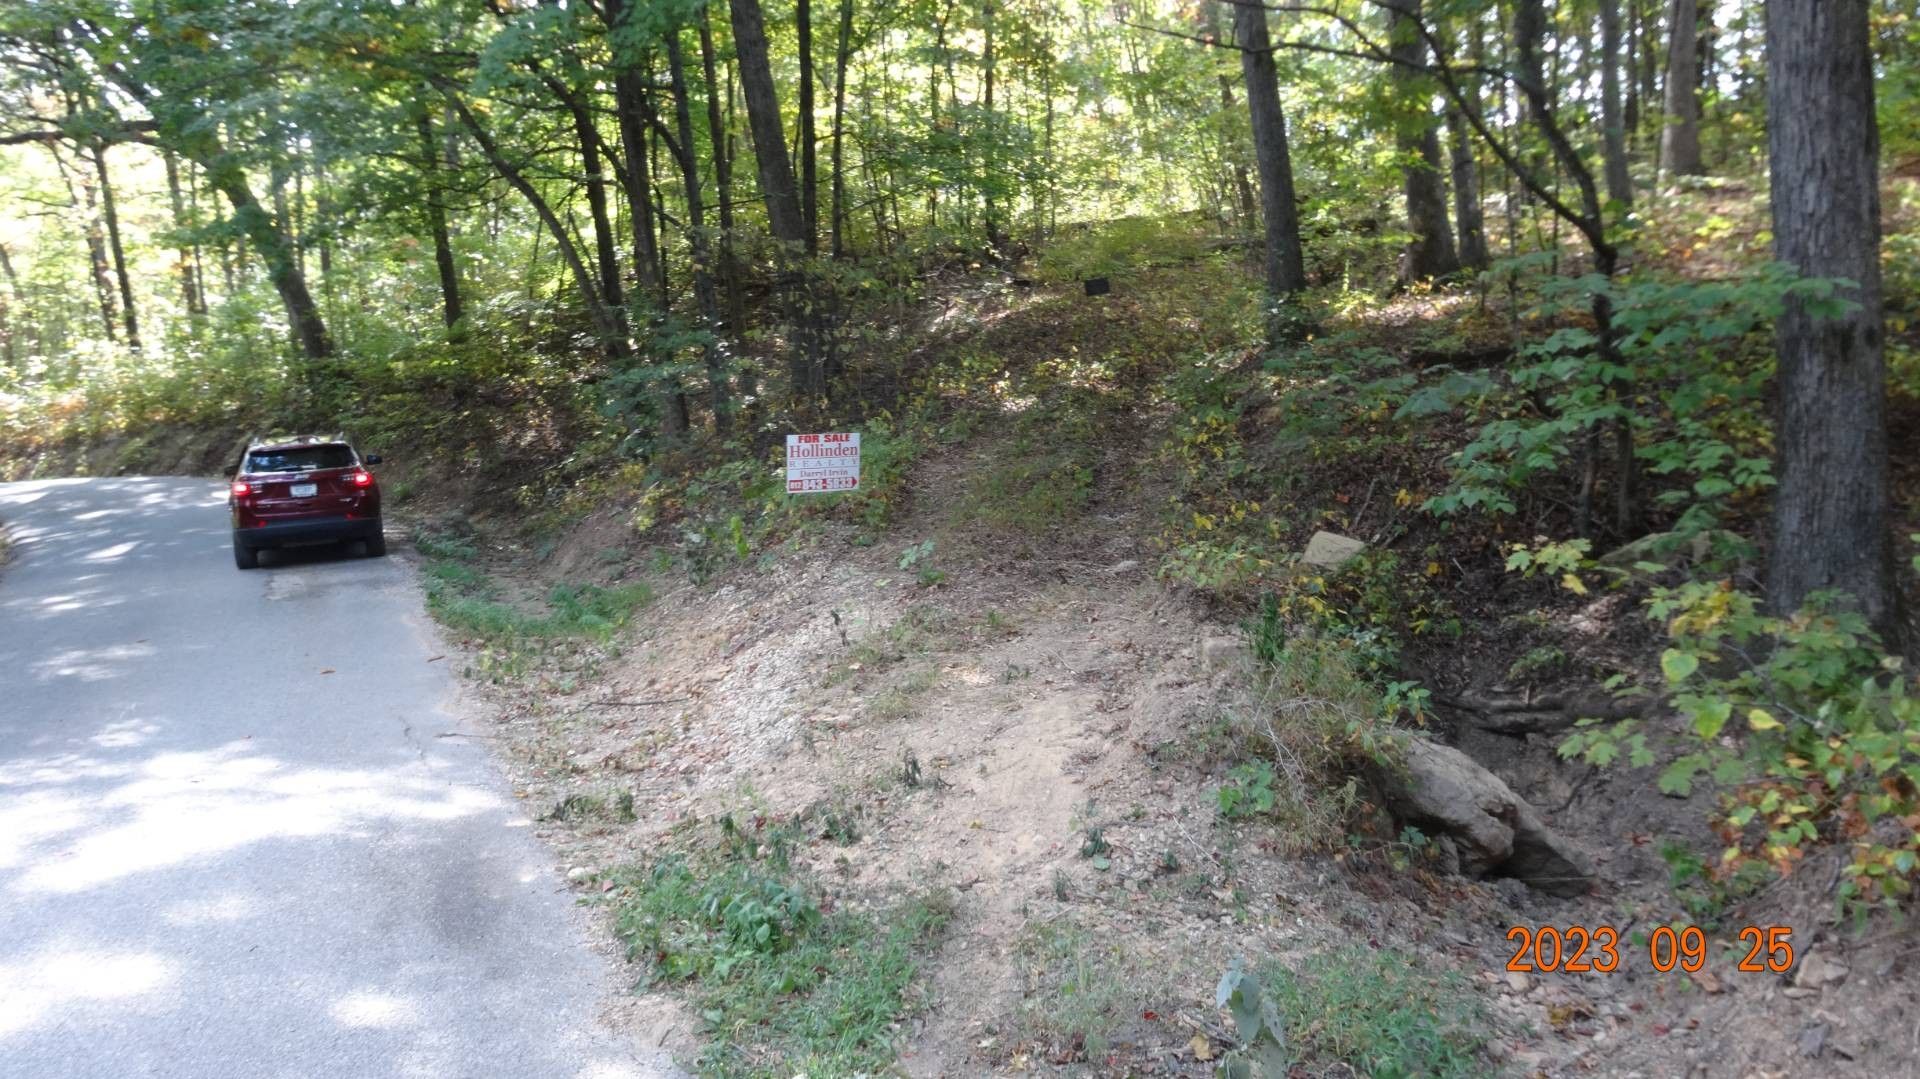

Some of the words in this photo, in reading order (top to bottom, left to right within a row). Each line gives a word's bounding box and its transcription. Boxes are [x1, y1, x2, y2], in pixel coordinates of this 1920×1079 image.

[798, 434, 820, 443] FOR
[824, 433, 850, 442] SALE
[790, 443, 858, 458] Hollinden
[789, 459, 858, 467] REALTY
[800, 469, 827, 478] Darryl
[829, 469, 849, 477] Irvin
